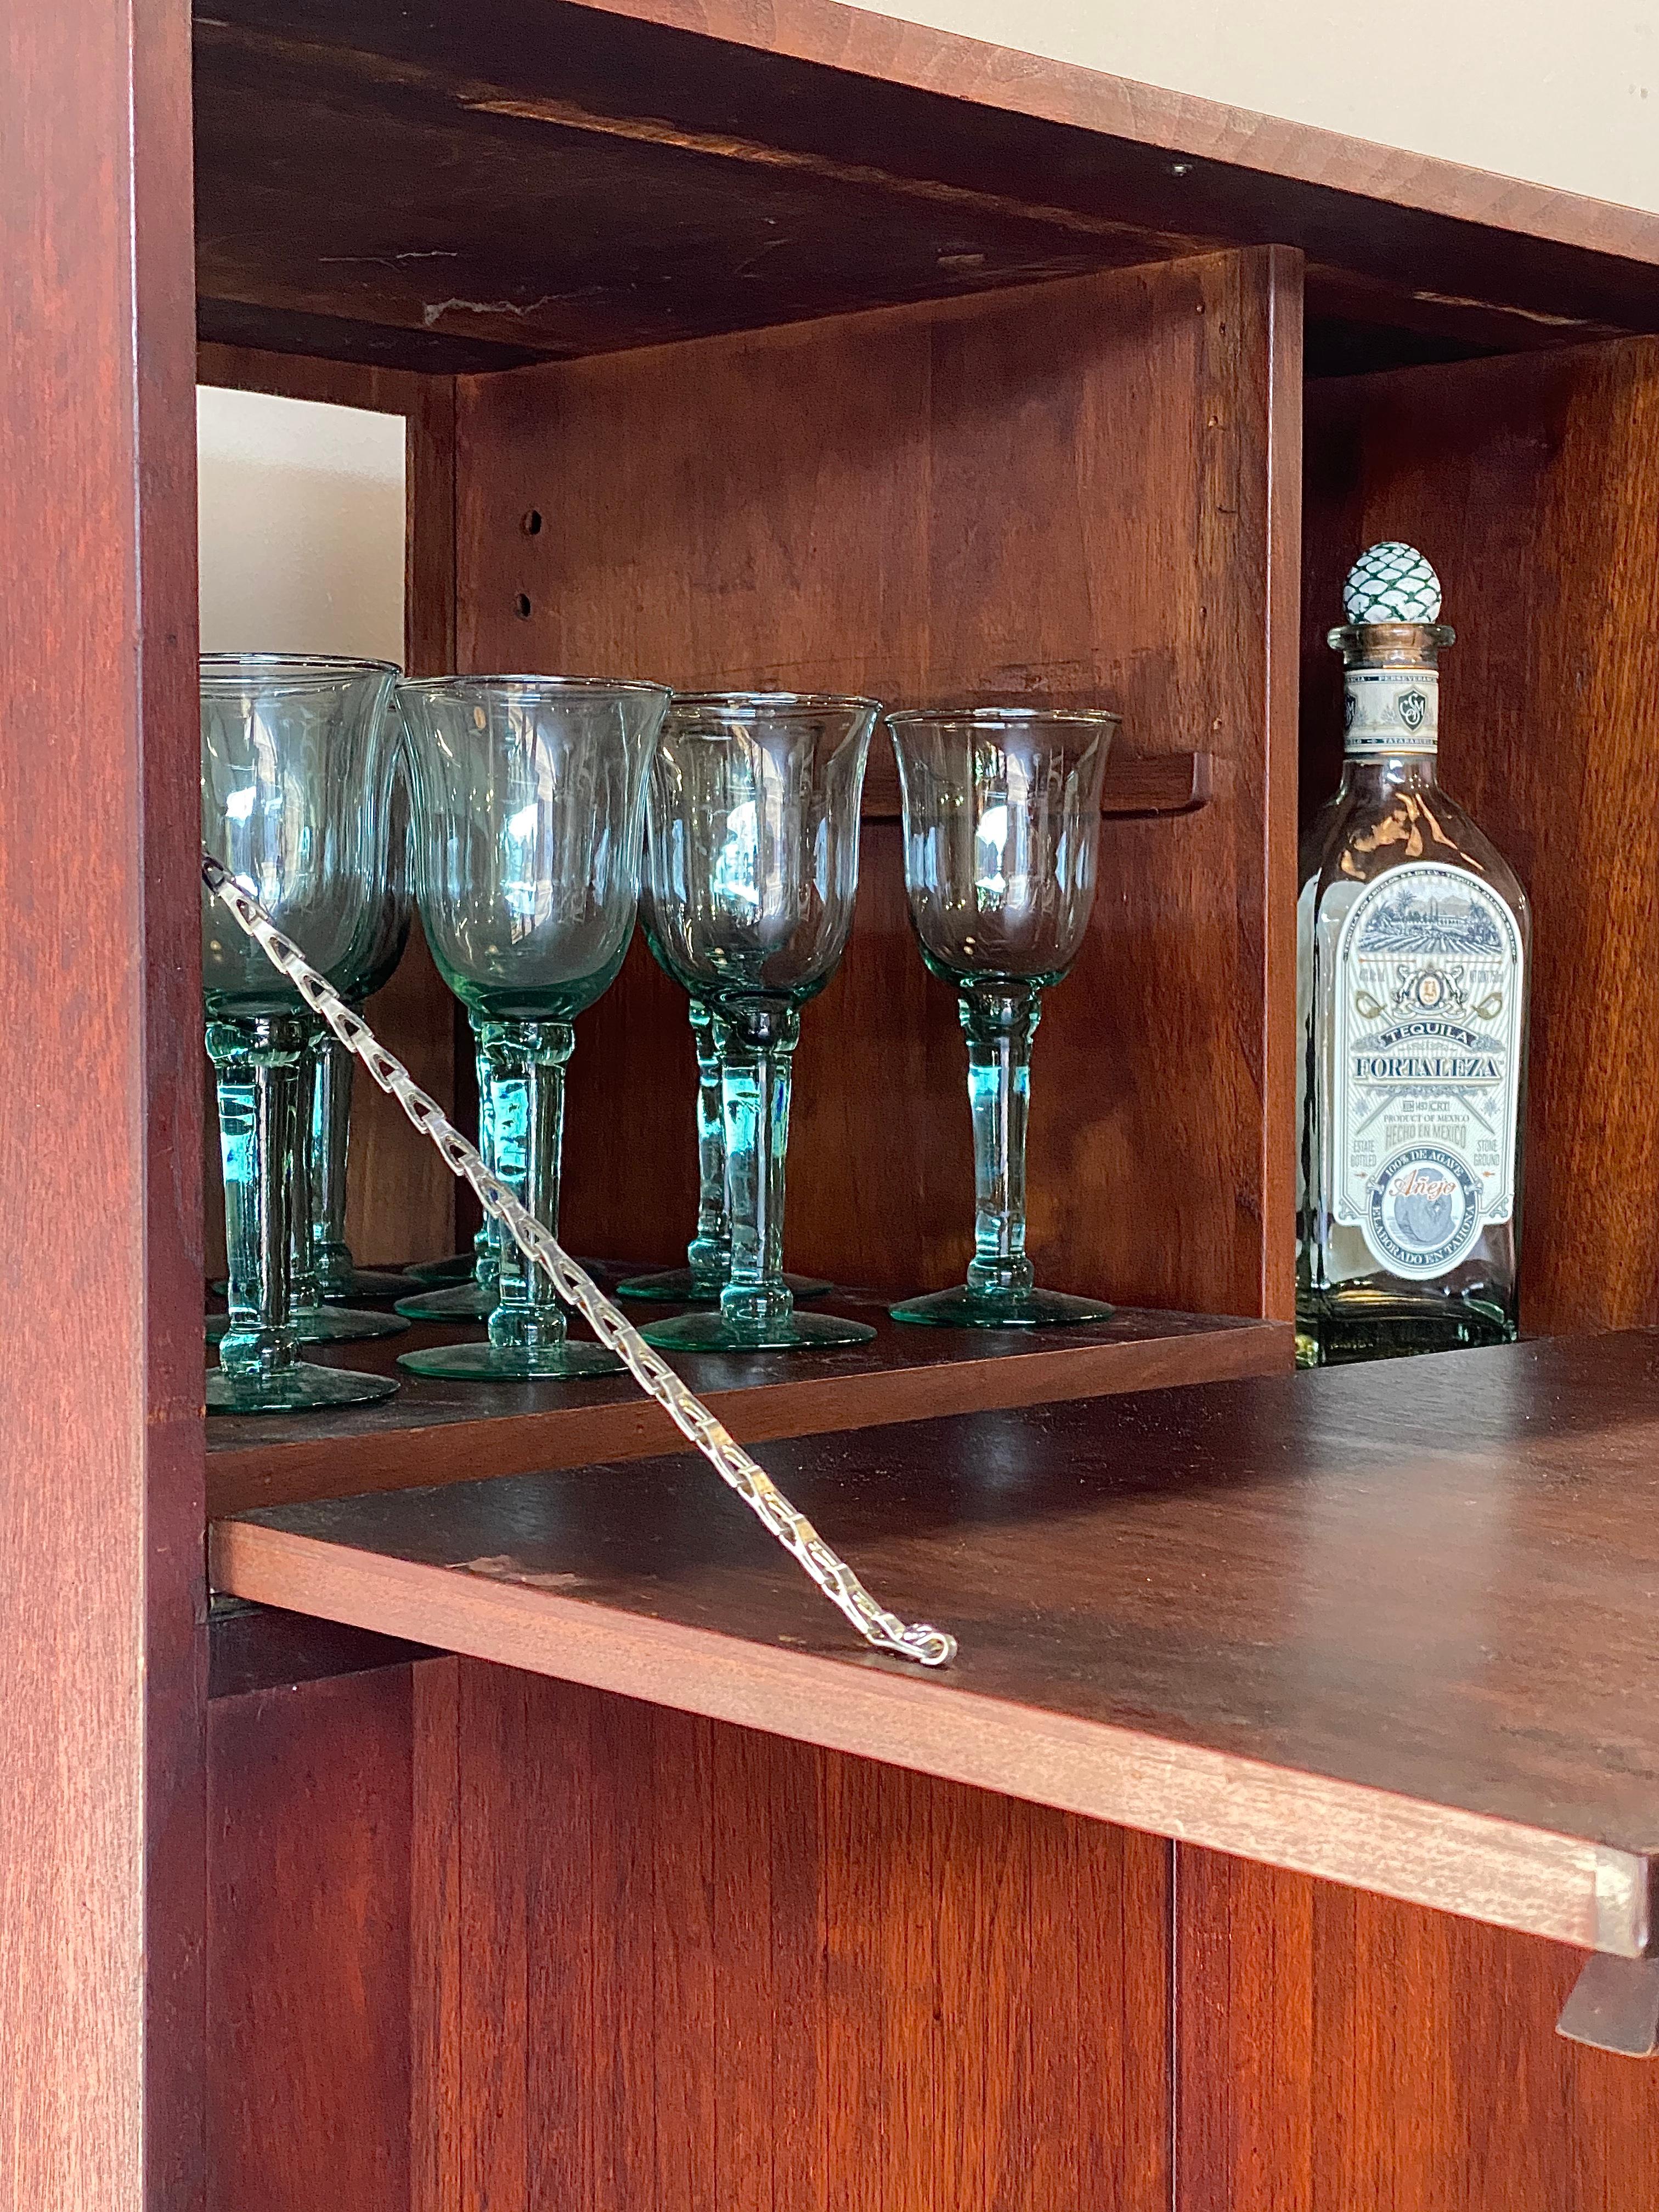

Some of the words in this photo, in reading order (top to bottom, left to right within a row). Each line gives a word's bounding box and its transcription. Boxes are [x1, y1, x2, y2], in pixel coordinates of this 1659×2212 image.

[1386, 1023, 1469, 1043] TEQUILA
[1355, 1057, 1500, 1079] FORTALEZA
[1384, 1114, 1421, 1122] PRODUCT
[1386, 1125, 1416, 1152] HECHO
[1418, 1125, 1431, 1138] EN
[1385, 1154, 1409, 1177] 100%
[1409, 1150, 1427, 1160] DE
[1431, 1151, 1464, 1177] AGAVE
[1389, 1169, 1457, 1200] Añejo
[1373, 1206, 1423, 1264] ELABORADO
[1426, 1250, 1444, 1263] EN
[1444, 1205, 1475, 1255] TAHONA
